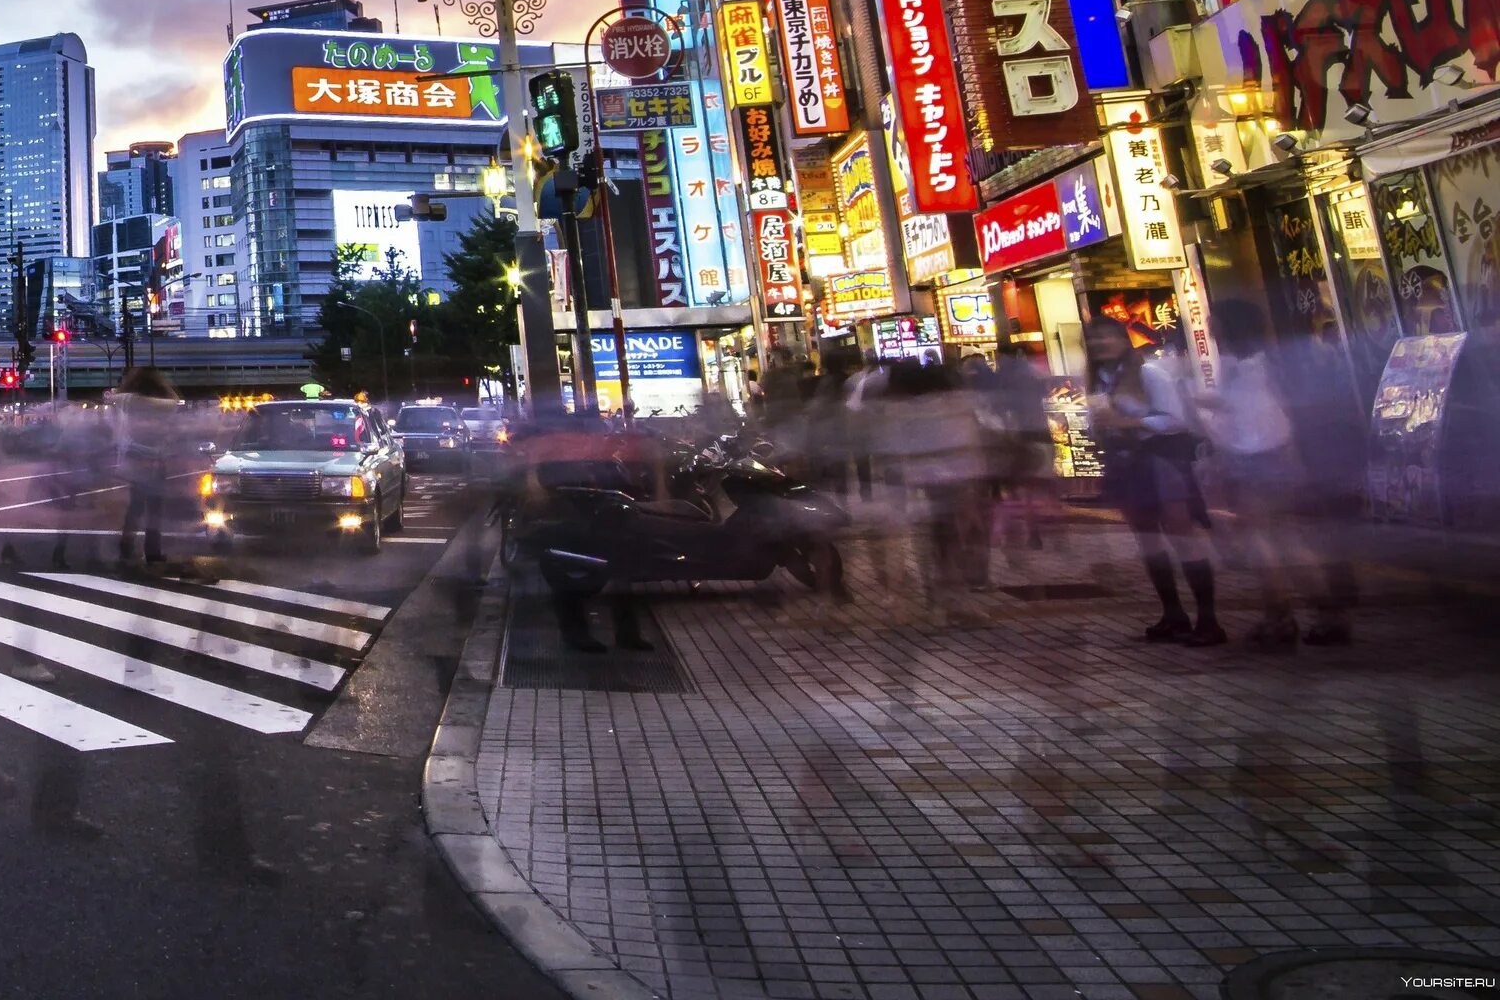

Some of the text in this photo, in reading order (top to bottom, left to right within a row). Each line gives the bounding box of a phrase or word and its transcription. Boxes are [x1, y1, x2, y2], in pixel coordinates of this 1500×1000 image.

[322, 39, 436, 73] たのめーる
[609, 34, 666, 60] 消火栓
[728, 5, 764, 84] 麻雀ブル
[813, 34, 840, 98] 焼き牛丼
[306, 77, 458, 109] 大塚商会
[601, 93, 626, 117] 質
[628, 96, 691, 117] セキネ
[744, 87, 764, 101] 6F
[627, 116, 667, 128] アルタ裏
[745, 108, 777, 178] お好み焼
[758, 192, 779, 206] 8F
[1128, 139, 1169, 241] 養老乃瀧
[651, 206, 685, 306] エスパス
[760, 216, 793, 283] 居酒屋
[774, 302, 797, 316] 4F
[591, 336, 684, 353] SUNADE
